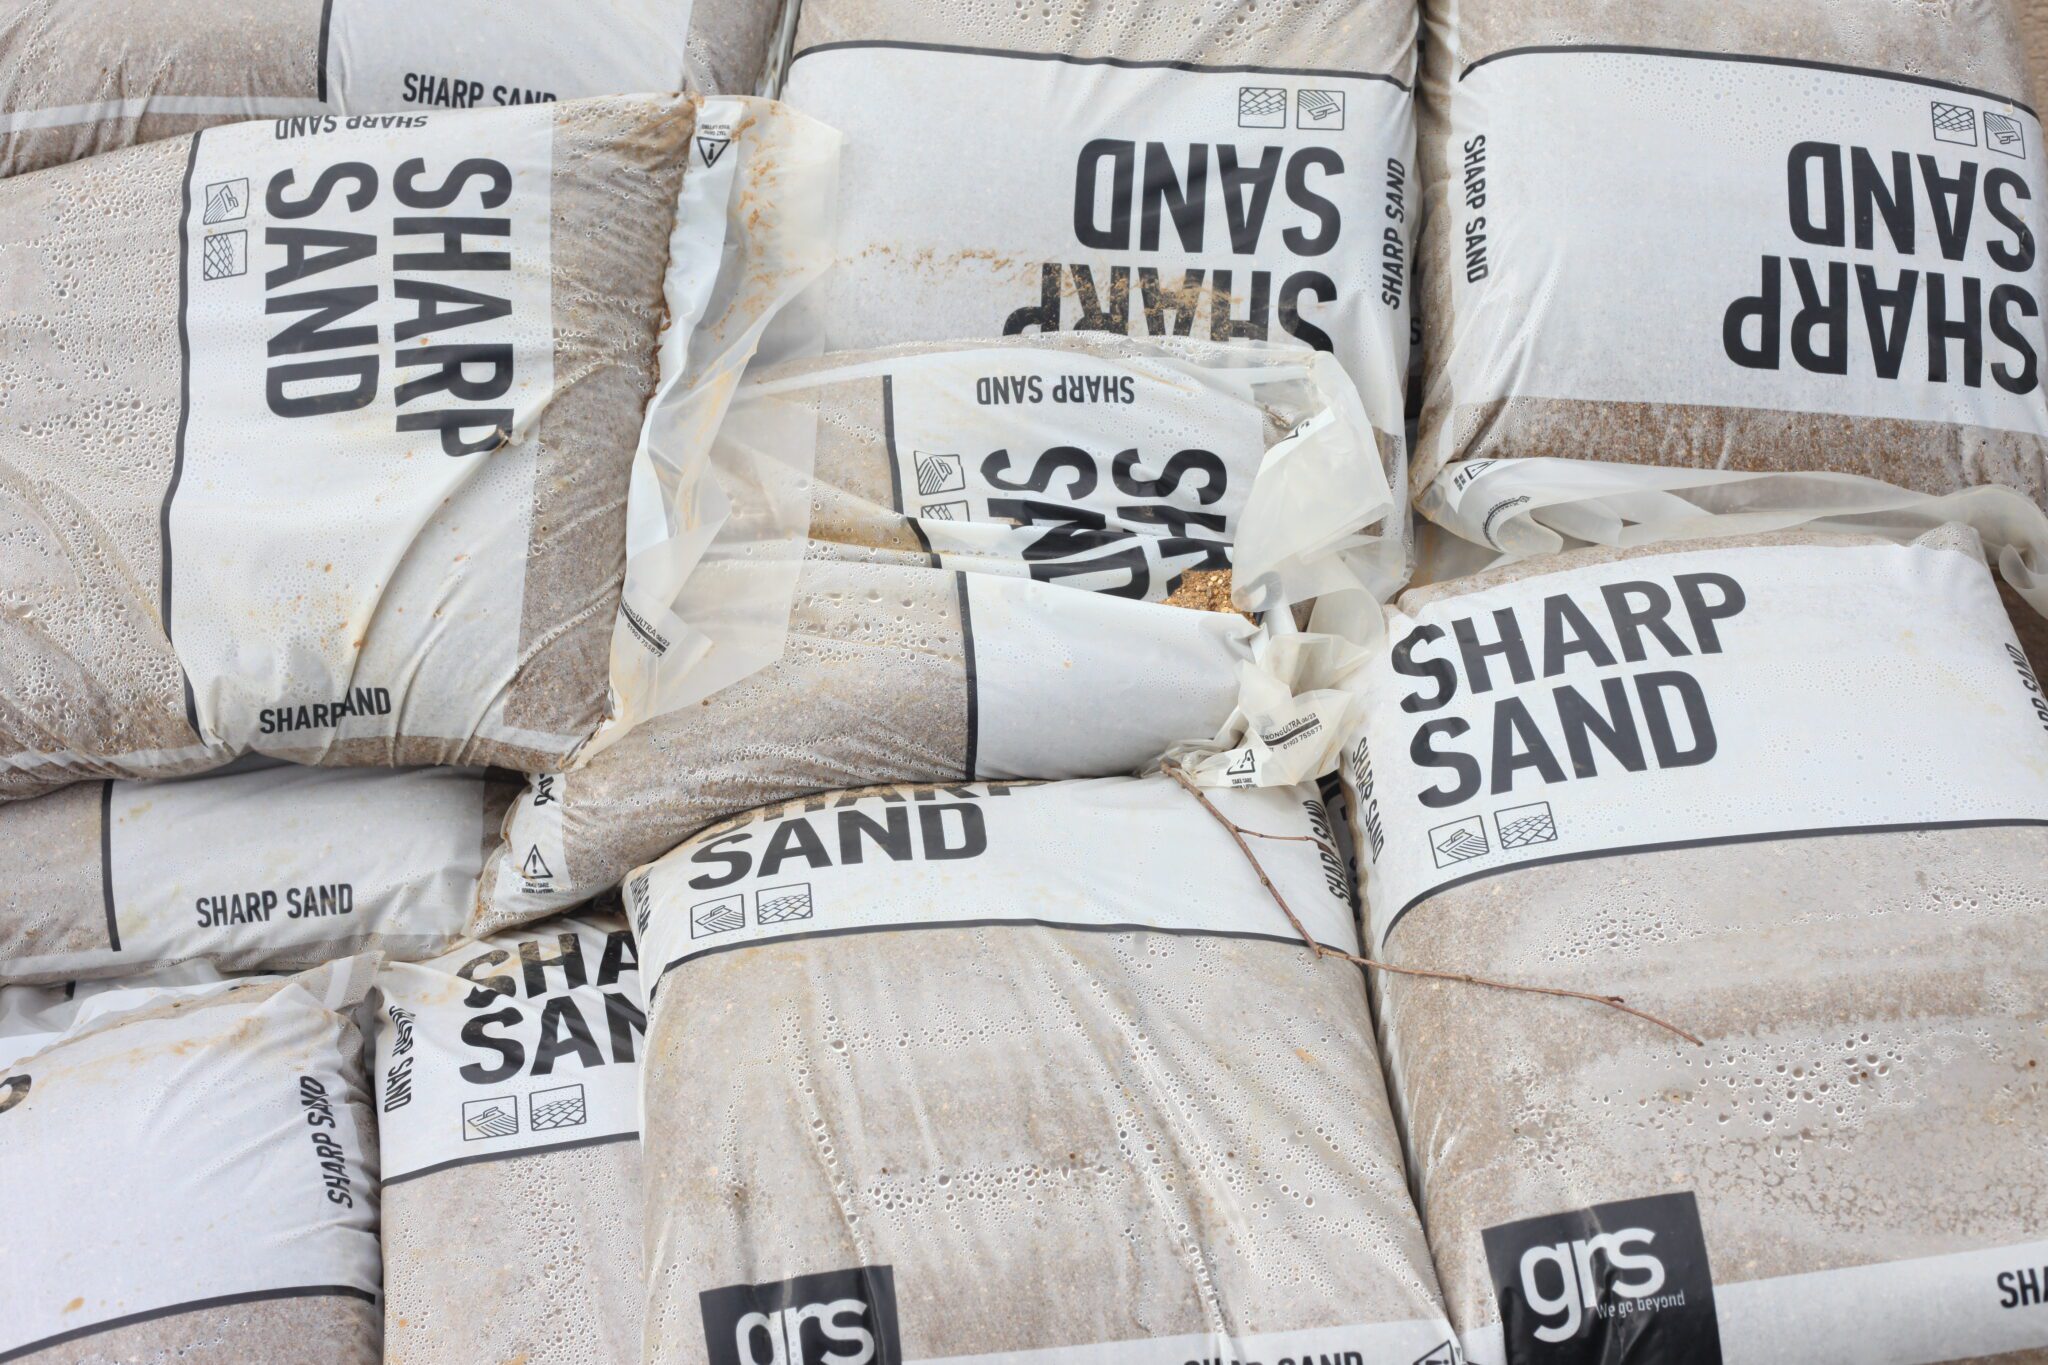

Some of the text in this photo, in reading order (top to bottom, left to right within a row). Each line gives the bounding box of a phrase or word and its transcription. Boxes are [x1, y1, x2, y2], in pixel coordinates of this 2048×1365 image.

[275, 114, 337, 140] SAND
[402, 72, 484, 108] SHARP
[1073, 138, 1345, 257] SAND
[1381, 157, 1406, 311] SHARP SAND
[1463, 134, 1489, 284] SHARP SAND
[1787, 140, 2036, 273] SAND
[265, 161, 379, 418] SAND
[392, 157, 513, 456] SHARP
[1722, 254, 2040, 395] SHARP
[976, 375, 1135, 406] SHARP SAND
[1391, 571, 1747, 714] SHARP
[259, 687, 391, 734] SHARP AND
[1410, 669, 1718, 809] SAND
[688, 802, 987, 891] SAND
[1302, 799, 1337, 849] SAND
[1352, 736, 1385, 864] SHARP SAND
[196, 883, 353, 928] SHARP SAND
[456, 930, 641, 1009] SHA
[384, 1056, 412, 1113] SAND
[458, 992, 648, 1085] SAN
[300, 1076, 353, 1209] SHARP SAND
[1519, 1227, 1666, 1343] grs
[1637, 1289, 1686, 1312] beyond
